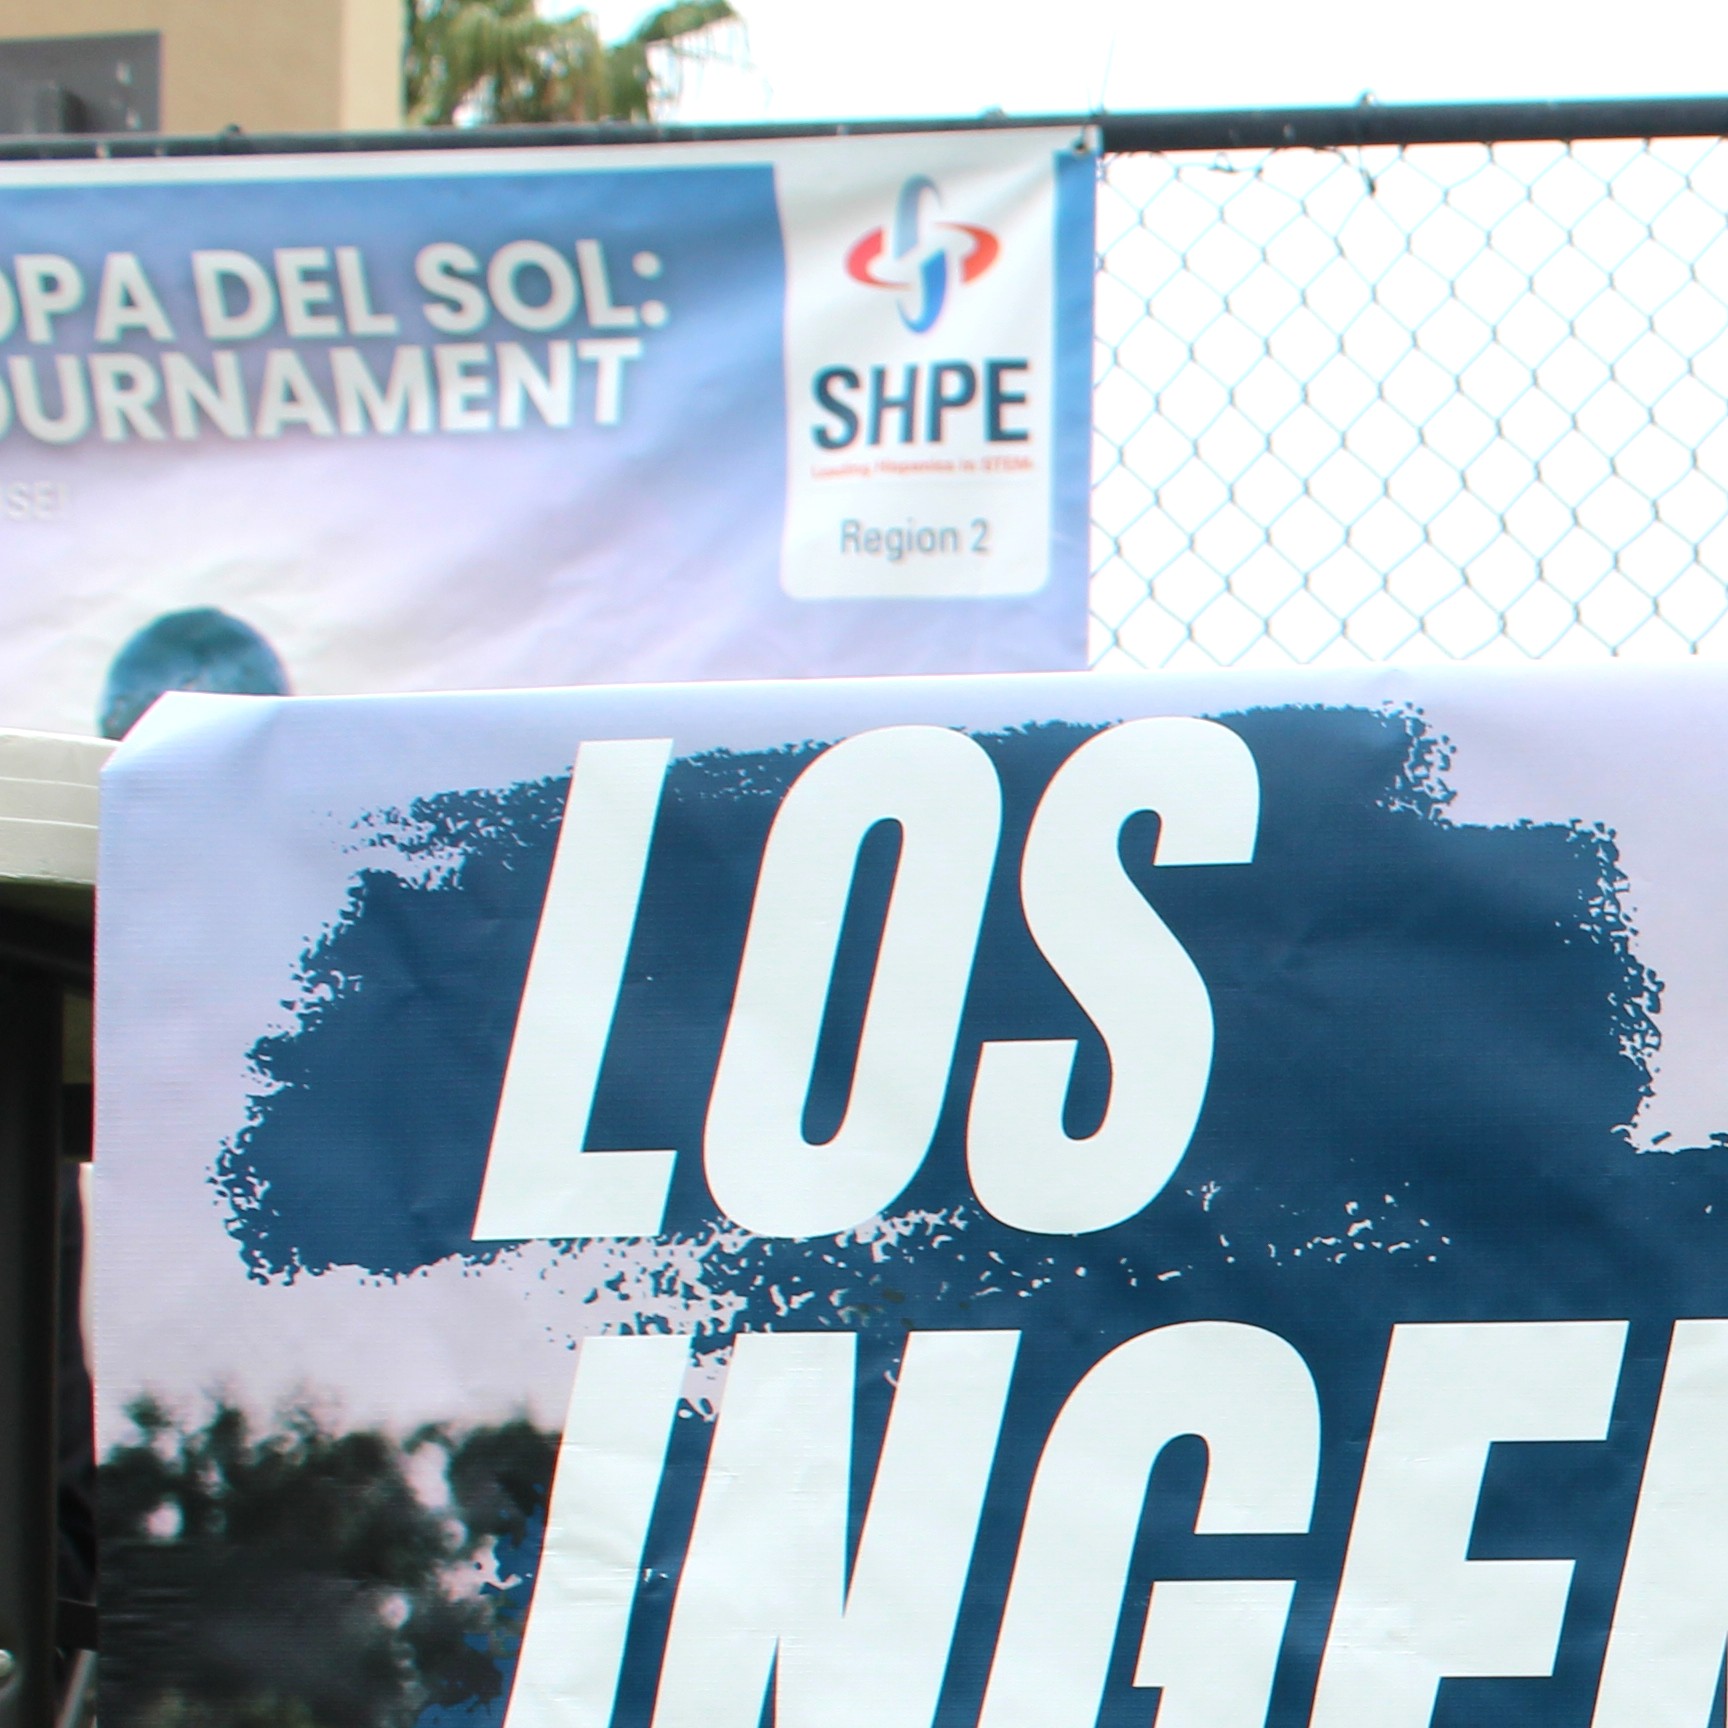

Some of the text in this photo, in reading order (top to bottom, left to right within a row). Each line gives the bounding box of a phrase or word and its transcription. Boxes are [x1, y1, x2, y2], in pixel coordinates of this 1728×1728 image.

[0, 238, 668, 345] PA DEL SOL:
[0, 336, 643, 444] URNAMENT
[811, 356, 1030, 451] SHPE
[839, 516, 990, 563] Region 2
[471, 715, 1261, 1239] LOS
